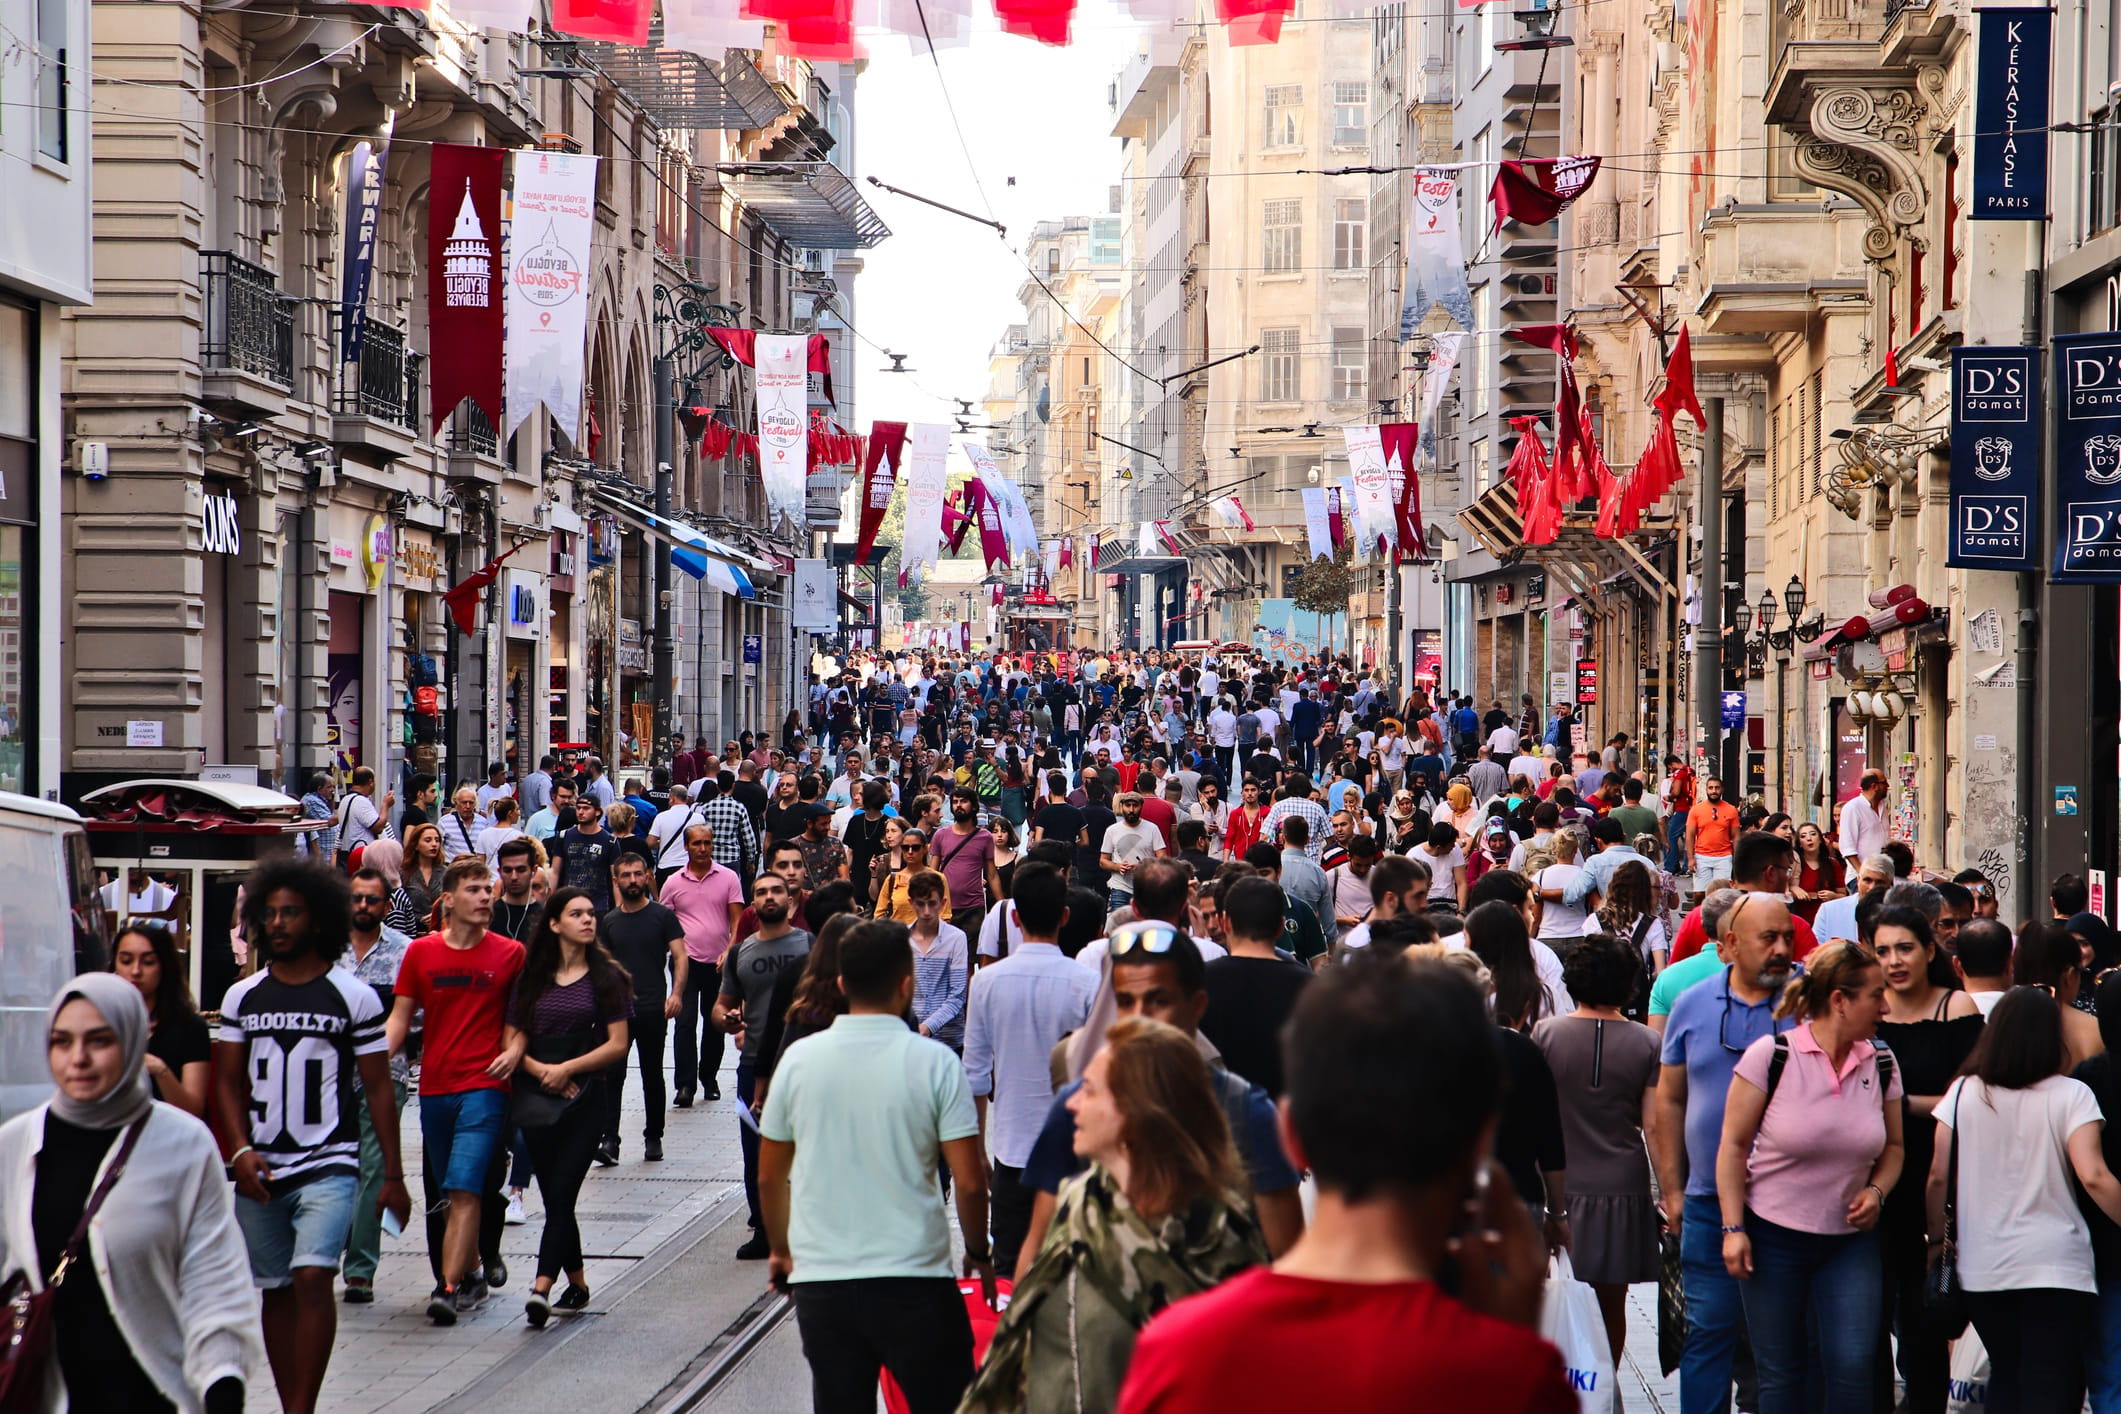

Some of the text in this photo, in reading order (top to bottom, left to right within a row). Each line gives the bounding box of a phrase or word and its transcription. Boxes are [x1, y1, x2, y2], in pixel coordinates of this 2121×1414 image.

[2003, 21, 2022, 188] KÉRASTASE
[1988, 196, 2030, 208] PARIS
[2075, 356, 2121, 388] D'
[1967, 367, 2021, 395] D'S
[1967, 398, 2022, 410] damat
[2075, 393, 2121, 405] dama
[760, 420, 804, 436] Festivali
[768, 415, 796, 425] BEYOĞLU
[1985, 455, 2001, 464] D'S
[2096, 456, 2115, 465] D'S
[202, 488, 240, 556] OLIN'S
[1965, 505, 2019, 532] D'S
[1965, 535, 2020, 547] damat
[2073, 546, 2121, 558] dama
[239, 1012, 349, 1035] BROOKLYN
[248, 1036, 340, 1147] 90
[1563, 1366, 1597, 1392] IKI
